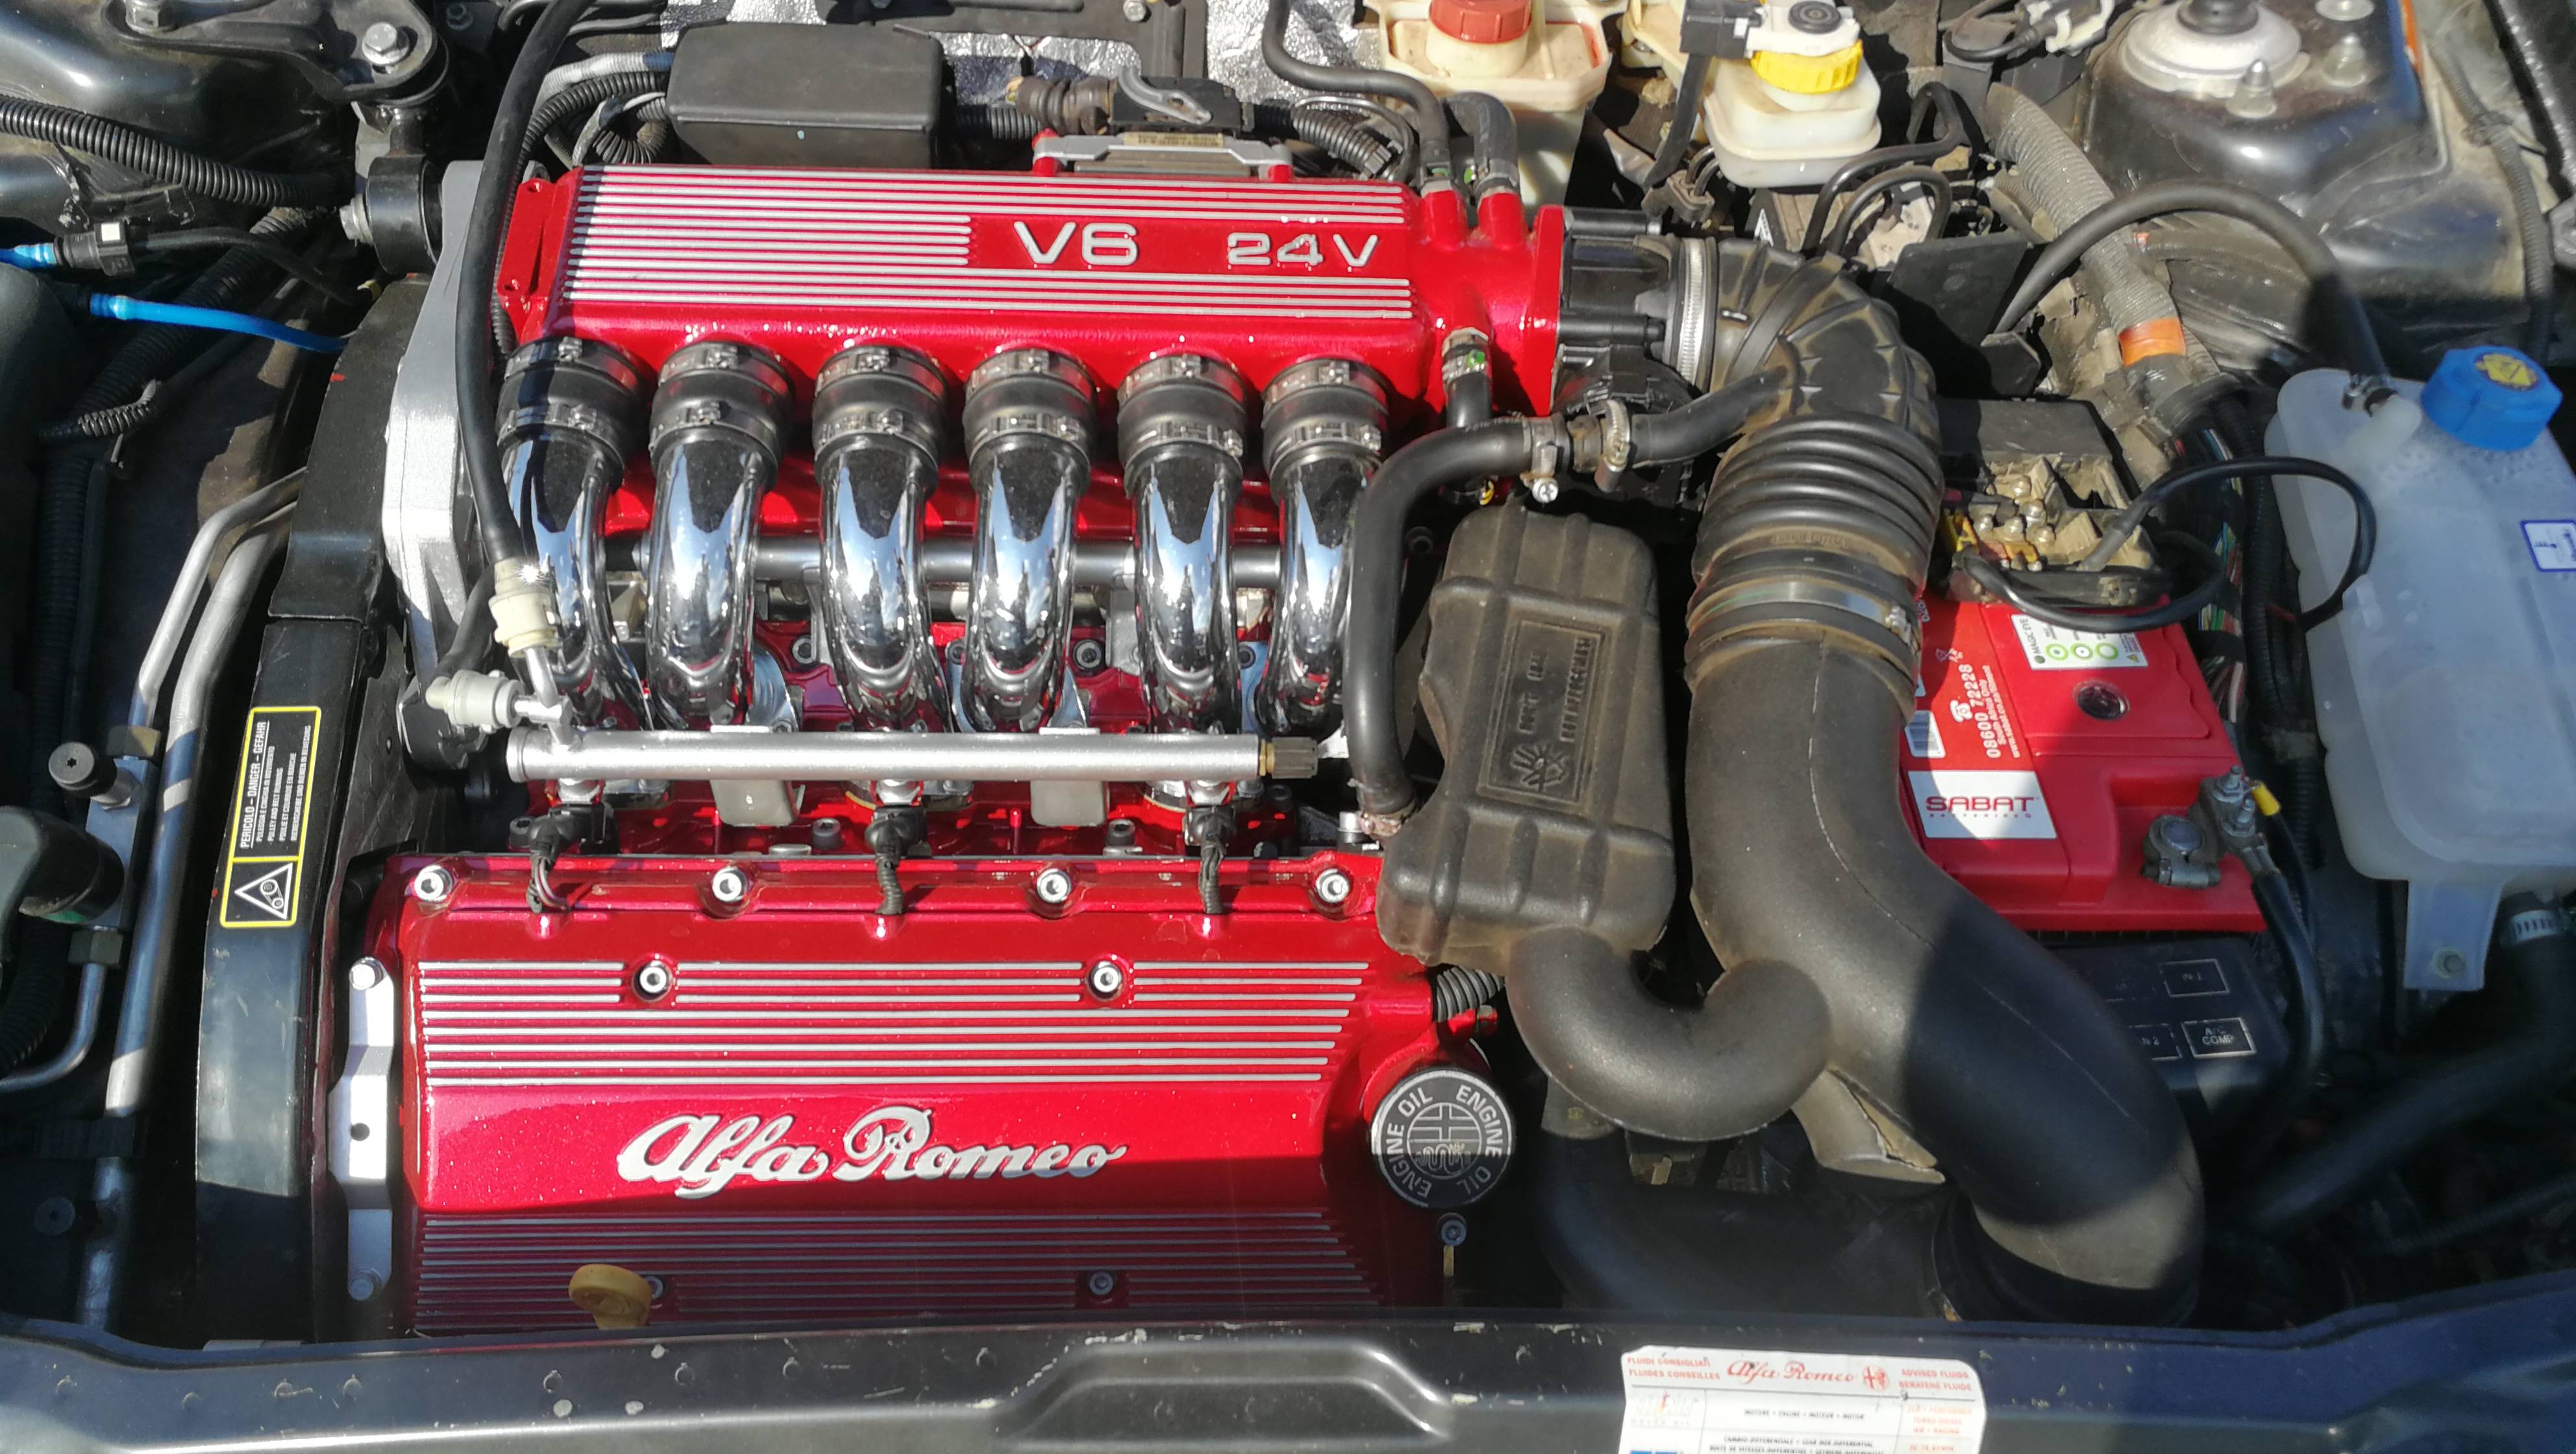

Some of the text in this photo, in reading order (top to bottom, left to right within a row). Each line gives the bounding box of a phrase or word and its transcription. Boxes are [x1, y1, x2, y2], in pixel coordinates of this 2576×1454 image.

[1013, 221, 1380, 269] V6 24V
[2020, 618, 2040, 654] MAGIC EYE
[1958, 664, 2001, 759] 08600 72228
[1979, 679, 2007, 745] South Africa Only
[253, 721, 266, 754] GEFAHR
[247, 763, 260, 797] DANGER
[267, 819, 277, 842] PULLEY
[274, 767, 283, 793] RUNNING
[1926, 796, 2034, 811] SABAT
[240, 806, 255, 849] PERICOLO
[279, 819, 288, 841] POULIE
[2202, 1035, 2233, 1045] COMP
[617, 1105, 1128, 1200] Alfa Romeo
[1386, 1087, 1434, 1198] ENGINE OIL
[1455, 1084, 1503, 1196] ENGINE OIL
[1628, 1357, 1711, 1368] FLUIDI CONSIGLIATI
[1629, 1368, 1720, 1380] FLUIDES CONSEILLES
[1727, 1360, 1855, 1385] Alfa Romeo
[1901, 1368, 1968, 1379] ADVISED FLUIDS
[1942, 1382, 1972, 1390] FLUIDE
